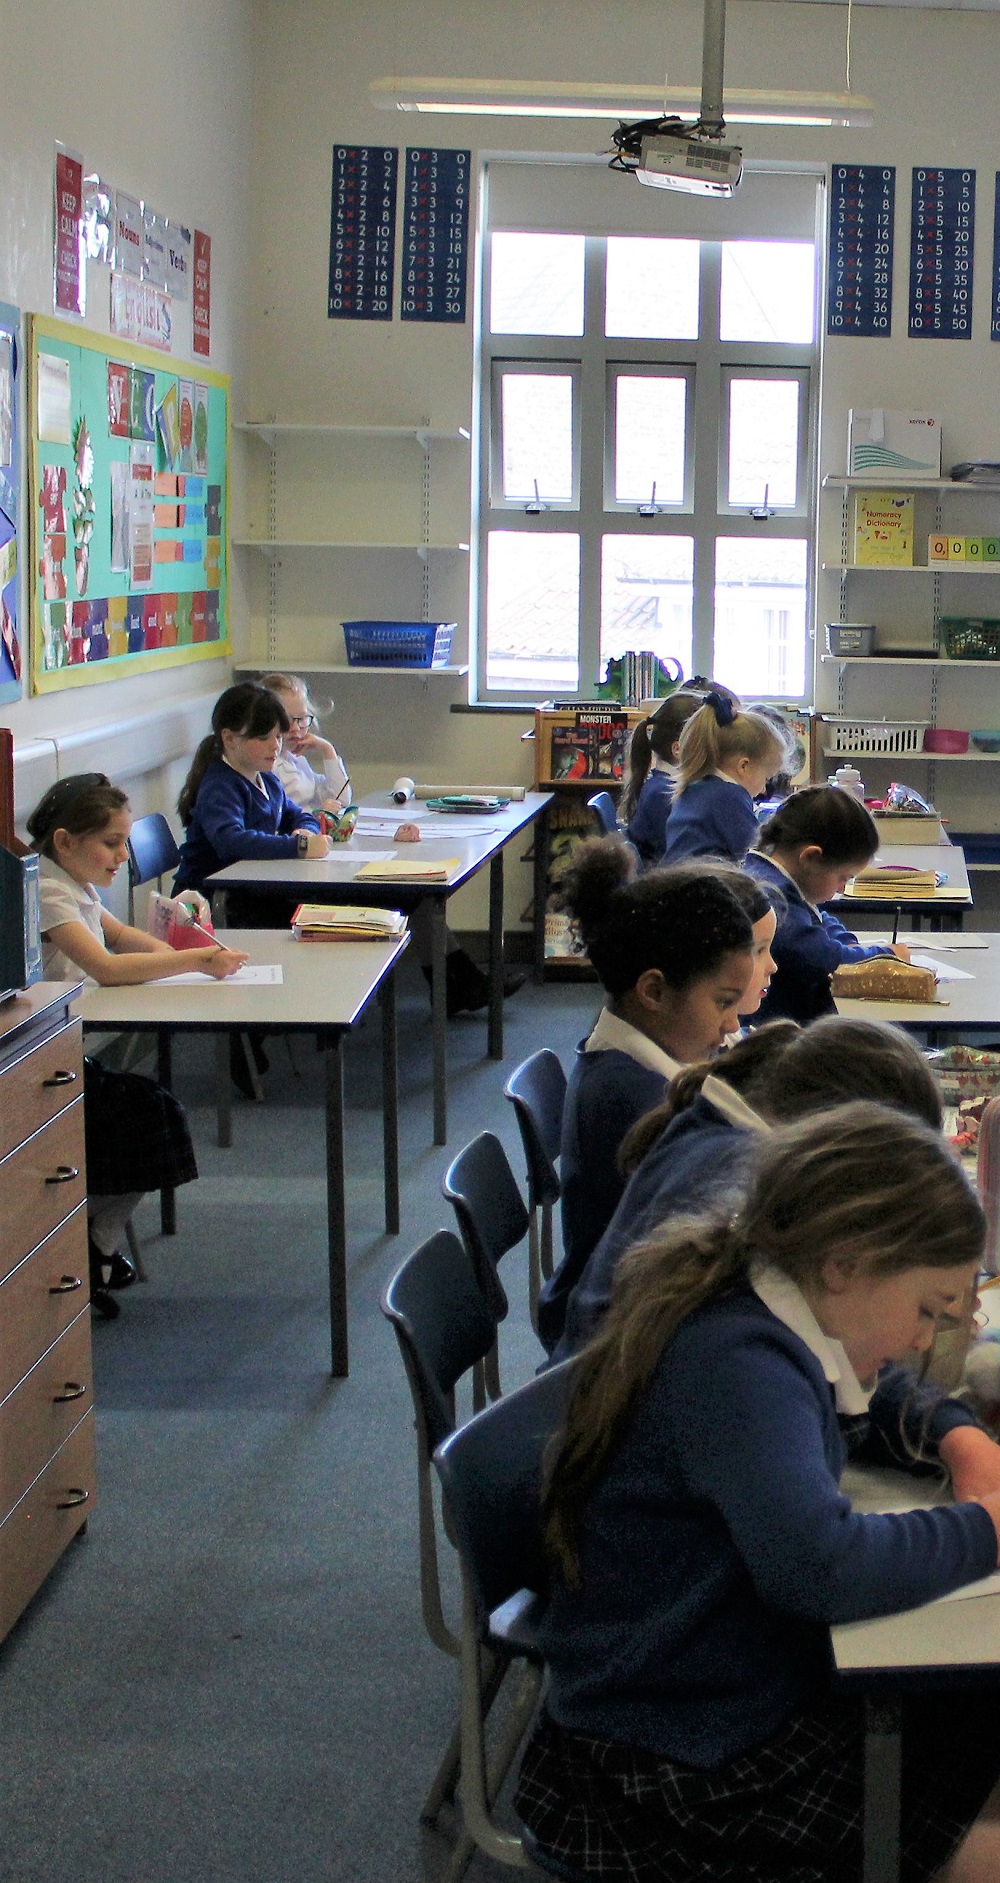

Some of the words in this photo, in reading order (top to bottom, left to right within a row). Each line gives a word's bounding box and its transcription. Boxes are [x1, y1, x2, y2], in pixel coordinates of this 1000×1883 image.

[337, 148, 347, 159] 0
[361, 148, 369, 160] 2
[383, 150, 393, 161] 0
[360, 164, 368, 176] 2
[384, 165, 392, 177] 2
[838, 167, 847, 178] 0
[858, 168, 865, 179] 4
[882, 169, 892, 180] 0
[338, 177, 346, 189] 2
[360, 179, 368, 191] 2
[383, 180, 390, 191] 4
[858, 183, 865, 194] 4
[882, 184, 890, 195] 4
[338, 193, 345, 205] 3
[359, 194, 367, 205] 2
[382, 195, 391, 207] 6
[838, 197, 846, 208] 2
[857, 198, 865, 209] 4
[882, 198, 890, 210] 8
[337, 208, 344, 219] 4
[359, 209, 367, 221] 2
[381, 210, 390, 222] 8
[838, 212, 845, 223] 3
[857, 213, 864, 223] 4
[877, 213, 890, 224] 12
[119, 220, 140, 246] Nouns
[336, 223, 344, 234] 5
[358, 224, 366, 236] 2
[376, 225, 390, 237] 10
[837, 227, 845, 237] 4
[856, 227, 864, 238] 4
[877, 228, 889, 239] 16
[335, 238, 344, 249] 6
[358, 239, 366, 250] 2
[376, 240, 389, 251] 12
[837, 241, 844, 252] 5
[856, 242, 863, 253] 4
[874, 242, 890, 254] 20
[335, 252, 343, 263] 7
[357, 254, 365, 265] 2
[375, 255, 388, 266] 14
[836, 256, 845, 267] 6
[856, 257, 863, 267] 4
[874, 257, 889, 269] 24
[334, 267, 343, 279] 8
[356, 268, 364, 280] 2
[374, 270, 388, 281] 16
[836, 270, 844, 281] 7
[855, 271, 863, 282] 4
[873, 272, 889, 283] 28
[334, 282, 343, 294] 9
[356, 284, 364, 295] 2
[374, 284, 387, 296] 18
[836, 285, 844, 296] 8
[855, 286, 862, 297] 4
[874, 286, 888, 298] 32
[329, 299, 343, 309] 10
[355, 299, 363, 310] 2
[372, 299, 388, 311] 20
[402, 301, 416, 311] 10
[426, 300, 433, 312] 3
[445, 301, 461, 313] 30
[835, 300, 844, 311] 9
[854, 300, 862, 311] 4
[873, 301, 888, 312] 36
[831, 314, 844, 325] 10
[854, 316, 862, 326] 4
[872, 316, 888, 327] 40
[909, 317, 923, 328] 10
[934, 317, 941, 328] 5
[952, 318, 967, 329] 50
[866, 510, 902, 520] Numeracy
[866, 519, 902, 529] Dictionary
[580, 714, 612, 724] MONSTER
